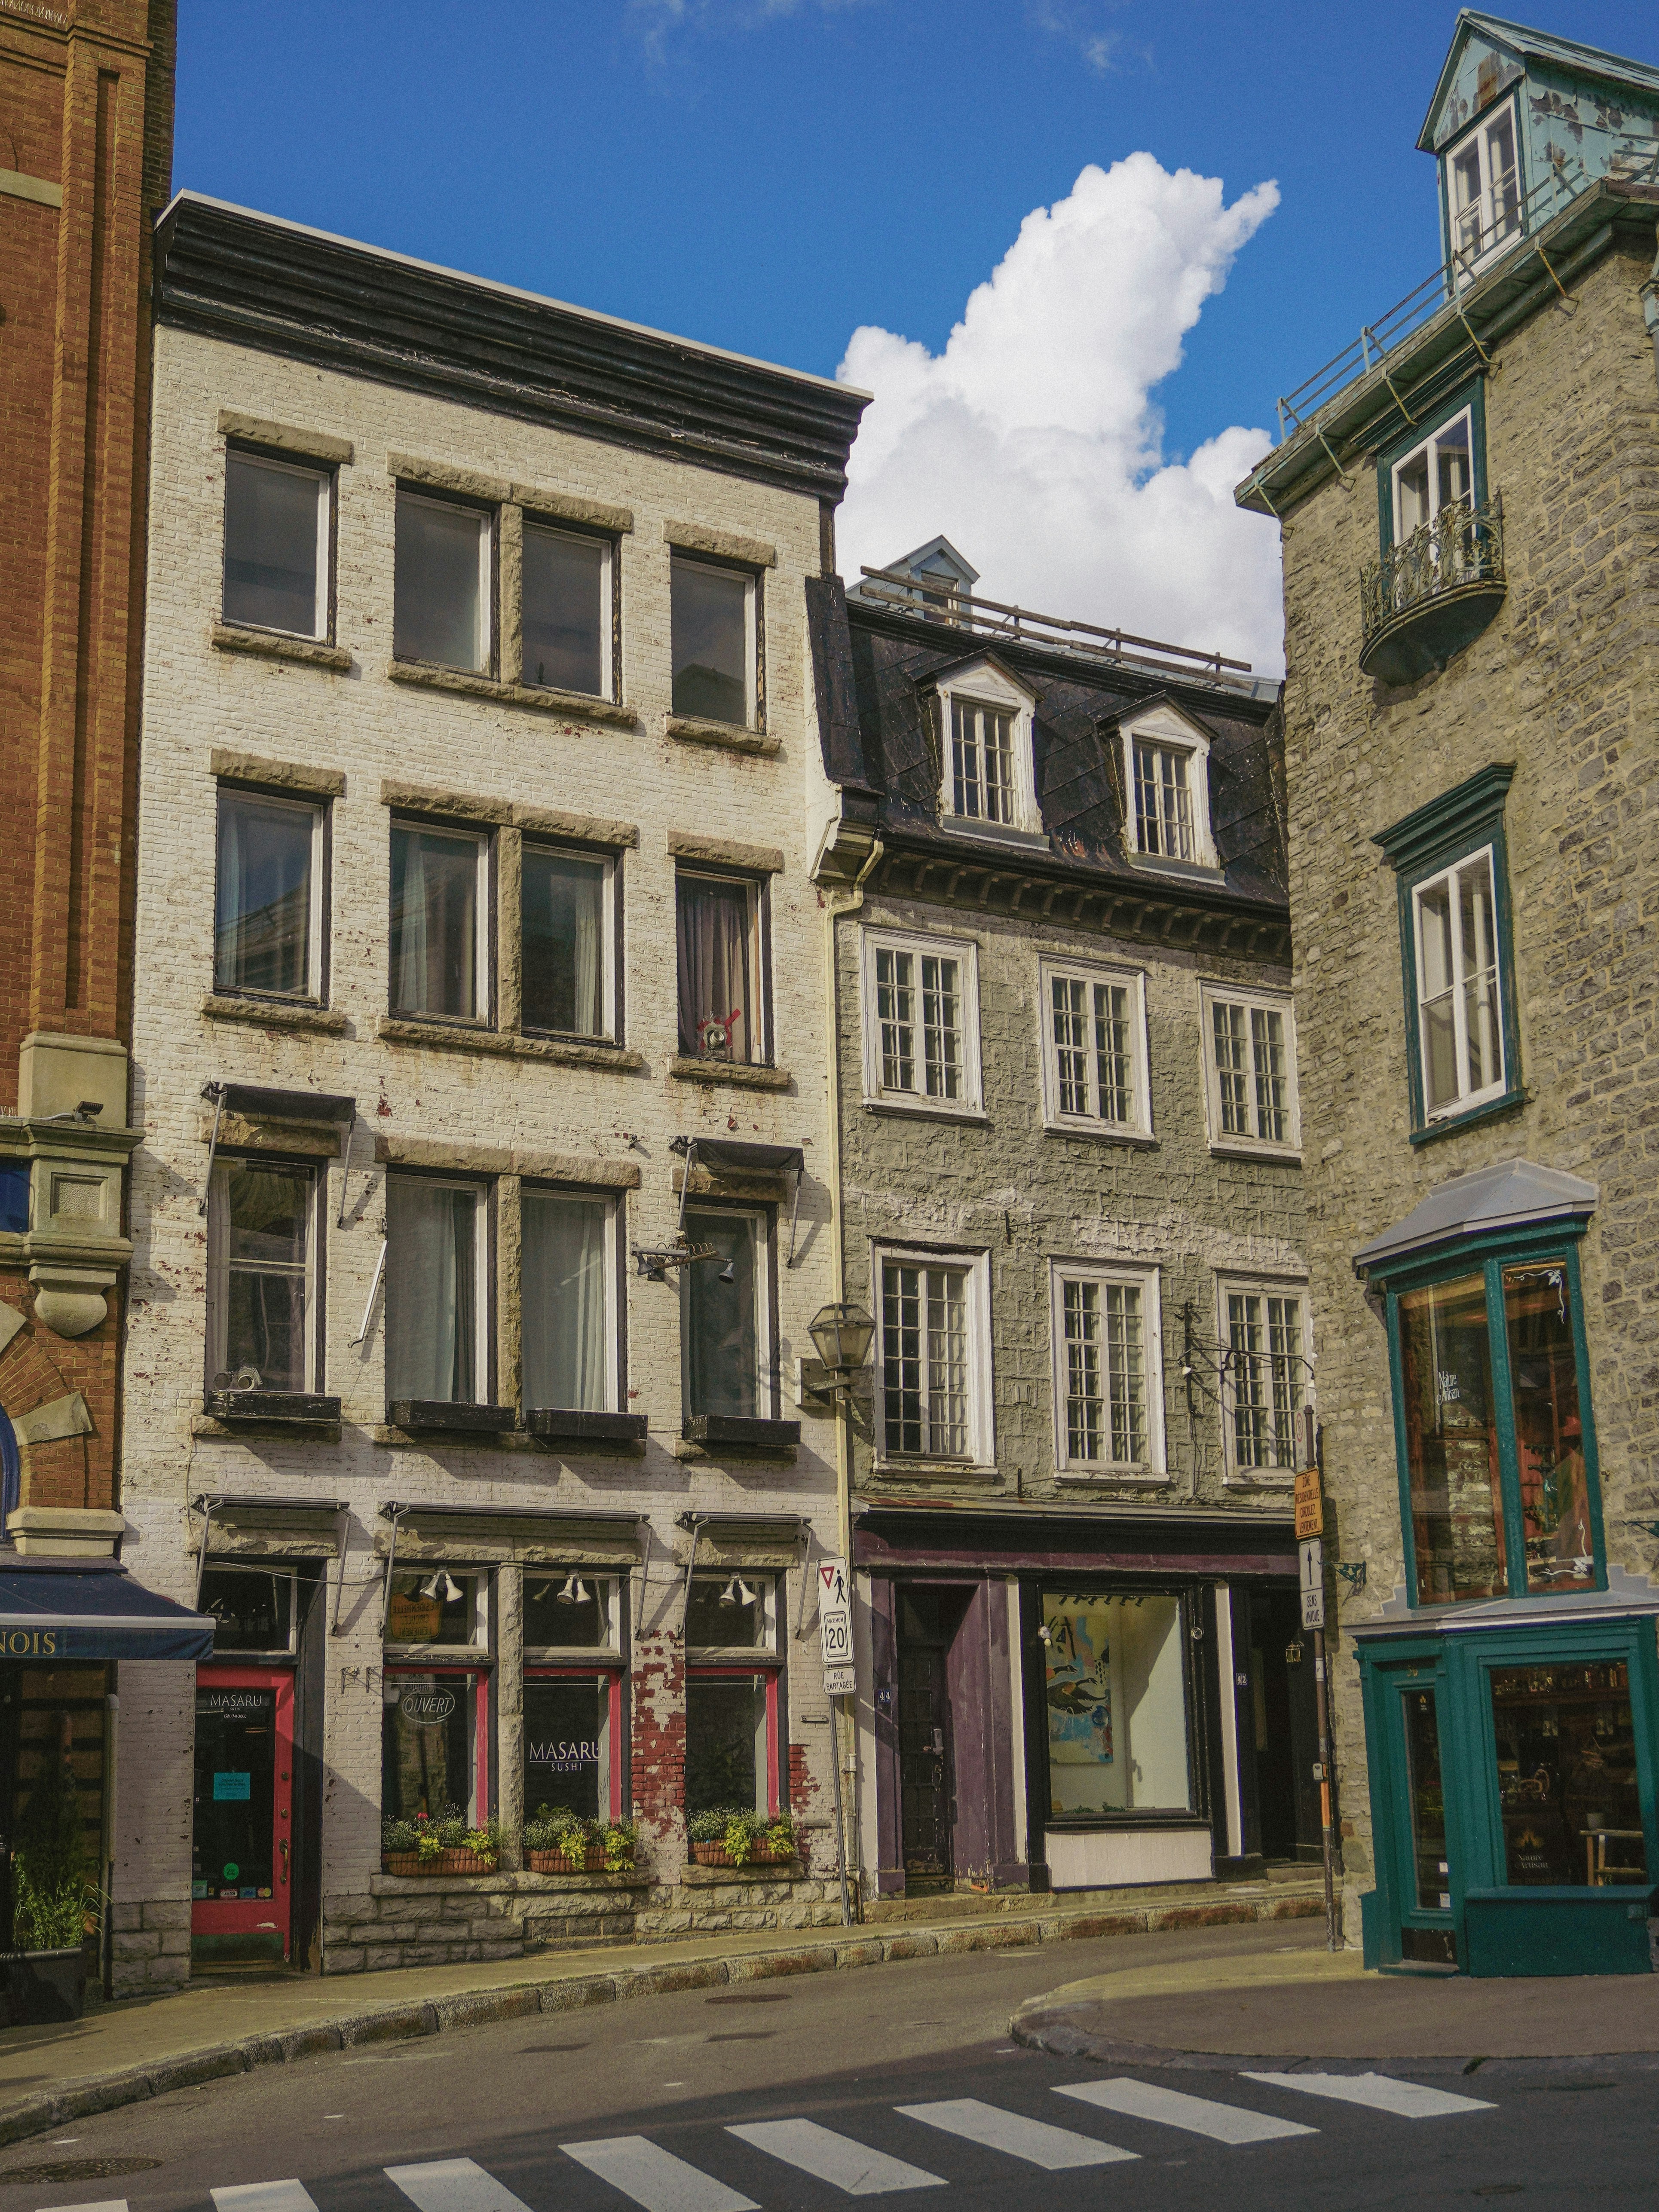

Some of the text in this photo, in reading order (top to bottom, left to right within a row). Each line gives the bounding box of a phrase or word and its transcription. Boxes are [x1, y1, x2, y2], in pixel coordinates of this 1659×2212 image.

[1439, 1371, 1457, 1389] Nature
[1436, 1387, 1460, 1406] Artisan
[1300, 1504, 1316, 1518] CIRCULEZ
[1299, 1518, 1318, 1533] LENTEMENT
[1307, 1594, 1317, 1608] SENS
[1305, 1609, 1320, 1624] UNIQUE
[829, 1627, 844, 1649] 20
[833, 1671, 844, 1680] RUE
[1238, 1675, 1246, 1683] 42
[826, 1680, 853, 1691] PARTAGÉE
[211, 1695, 261, 1707] MASARU
[879, 1691, 891, 1700] 44
[405, 1697, 452, 1713] OUVERT
[530, 1742, 603, 1759] MASARU
[551, 1762, 582, 1771] SUSHI
